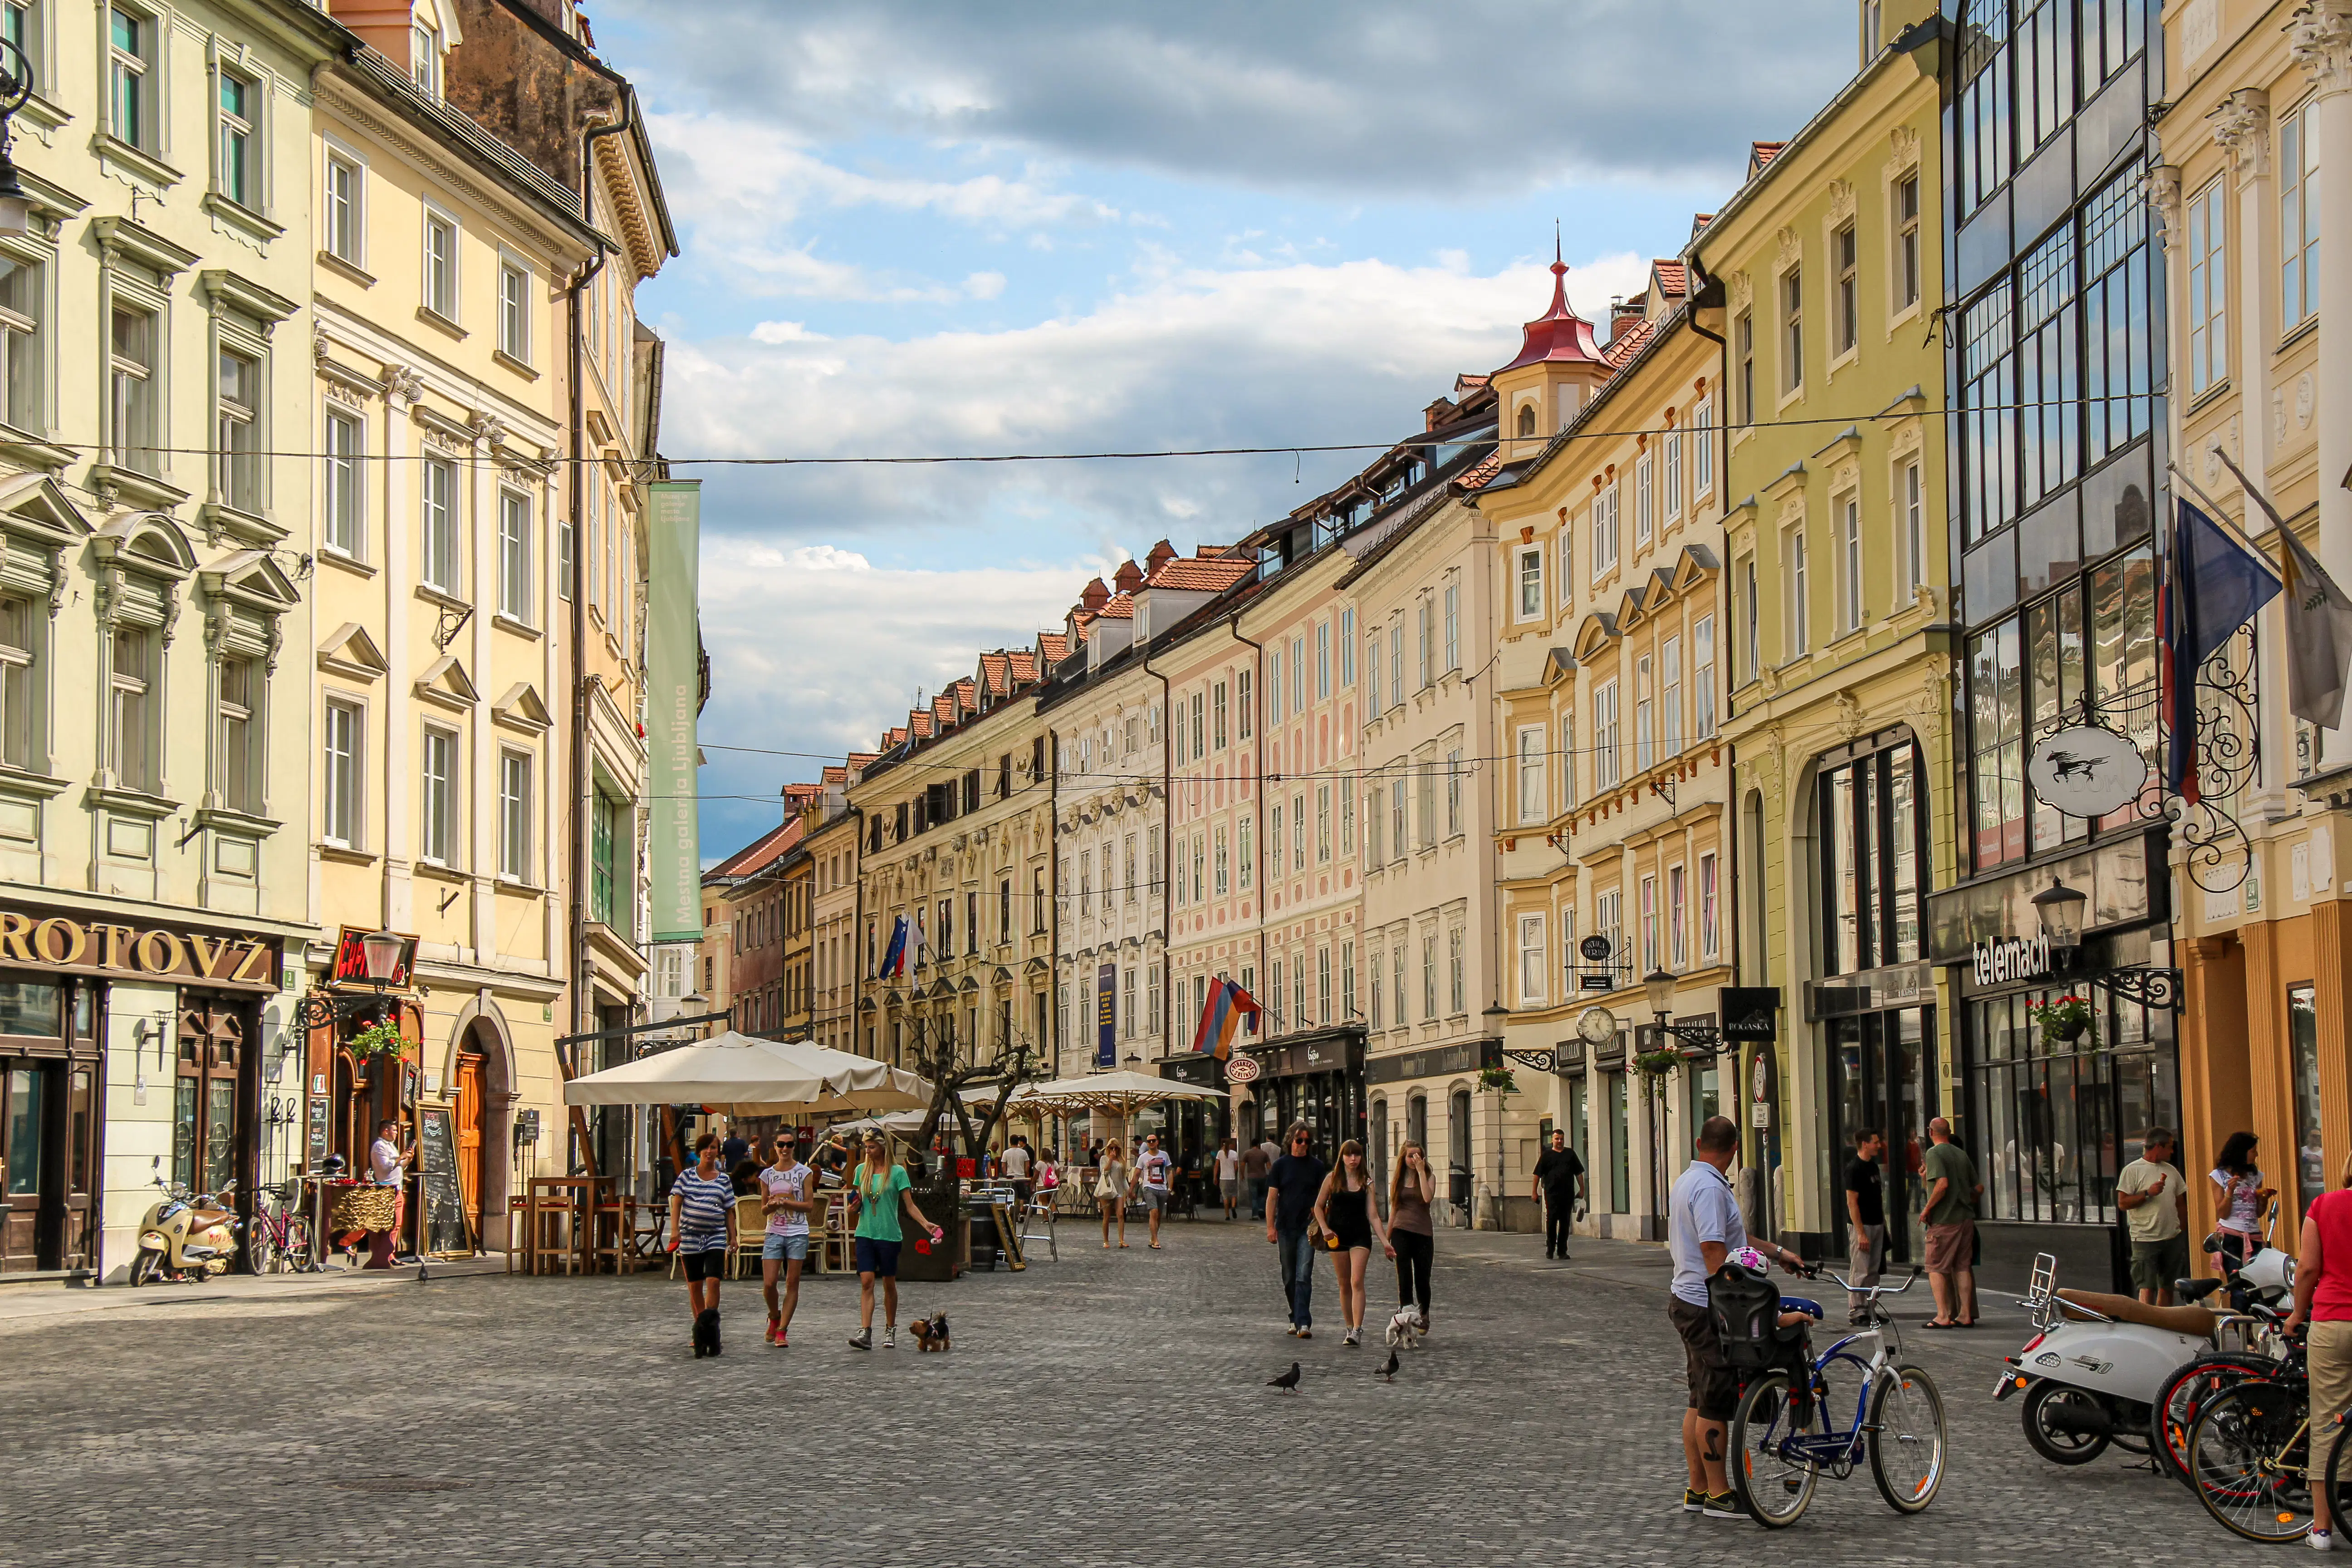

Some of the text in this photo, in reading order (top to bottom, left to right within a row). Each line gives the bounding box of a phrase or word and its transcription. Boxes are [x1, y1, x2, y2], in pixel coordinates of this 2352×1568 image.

[671, 685, 693, 924] Mestna galerija Ljubljana
[2248, 883, 2255, 897] 24
[0, 911, 267, 984] ROTOVŽ
[1973, 923, 2049, 986] telemach
[1232, 1062, 1254, 1070] PIRANSKE
